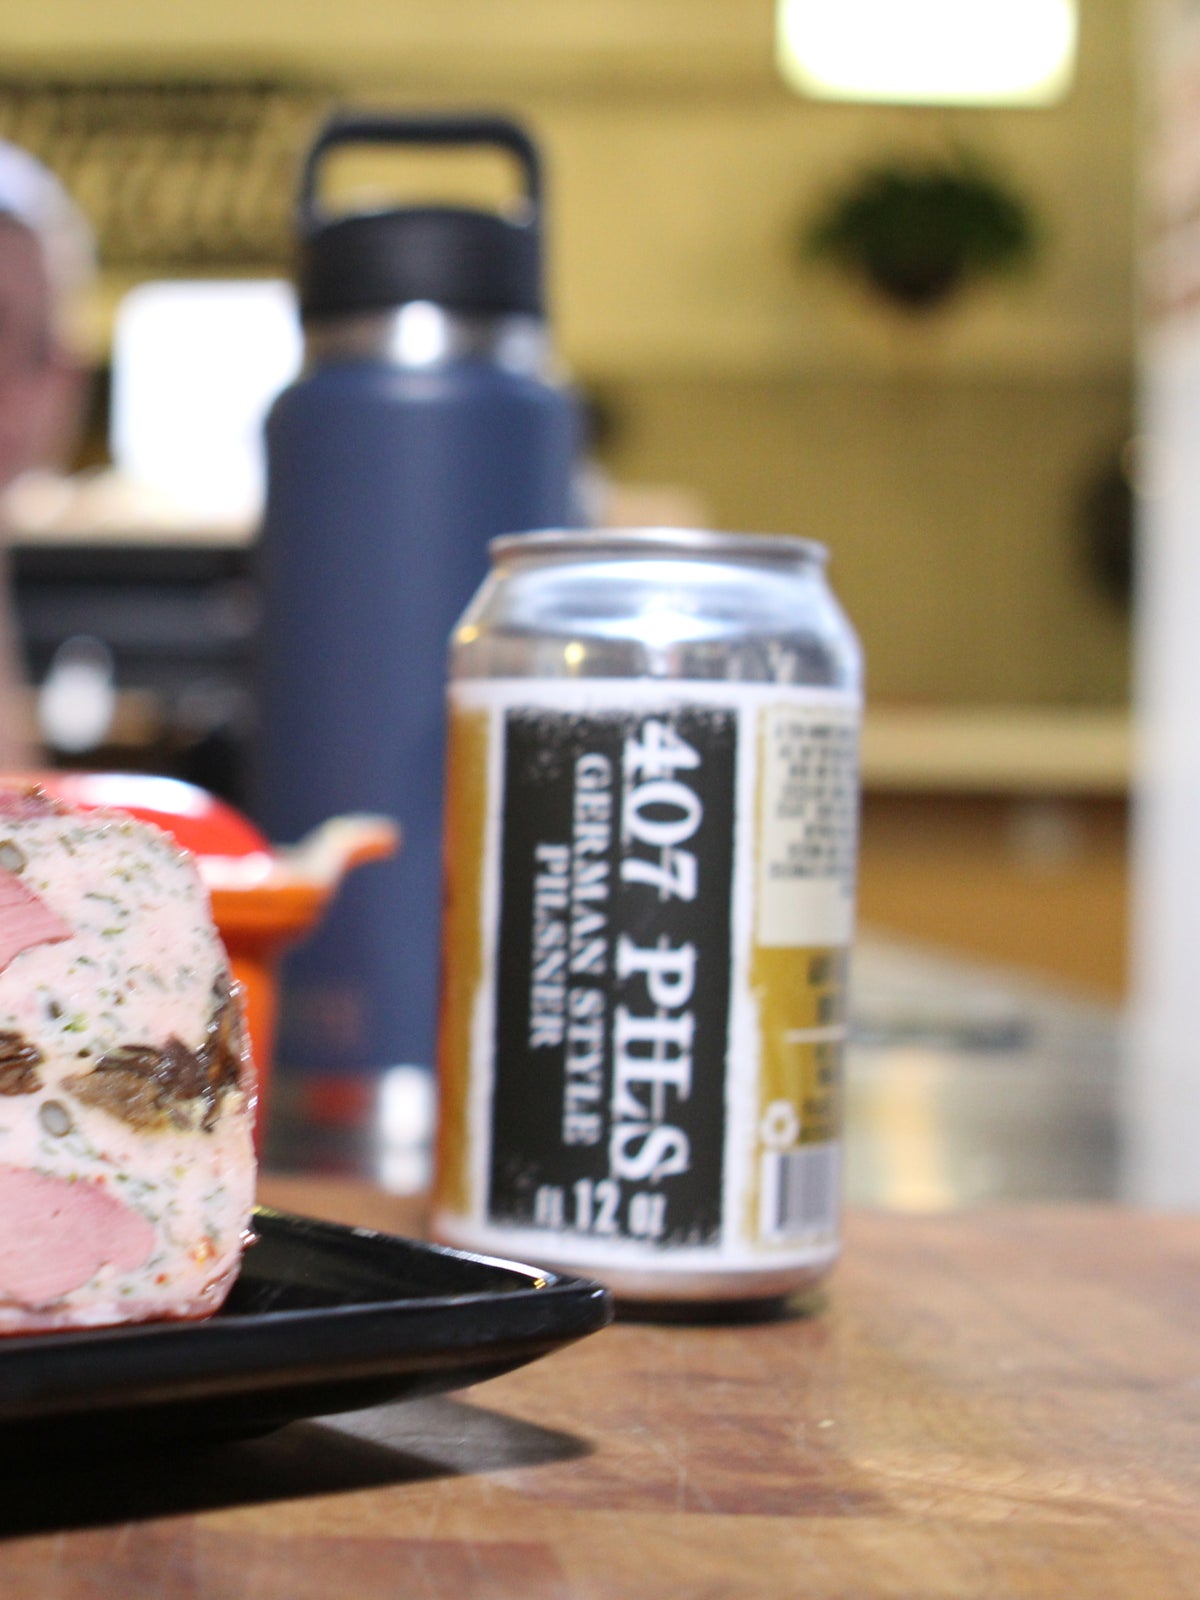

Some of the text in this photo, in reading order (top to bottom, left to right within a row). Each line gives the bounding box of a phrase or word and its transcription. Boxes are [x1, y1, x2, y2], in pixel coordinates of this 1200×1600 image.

[529, 843, 570, 1049] PILSNER
[563, 753, 612, 1146] GERMAN STYLE
[609, 721, 701, 1182] 407 PILS
[574, 1178, 620, 1233] 12
